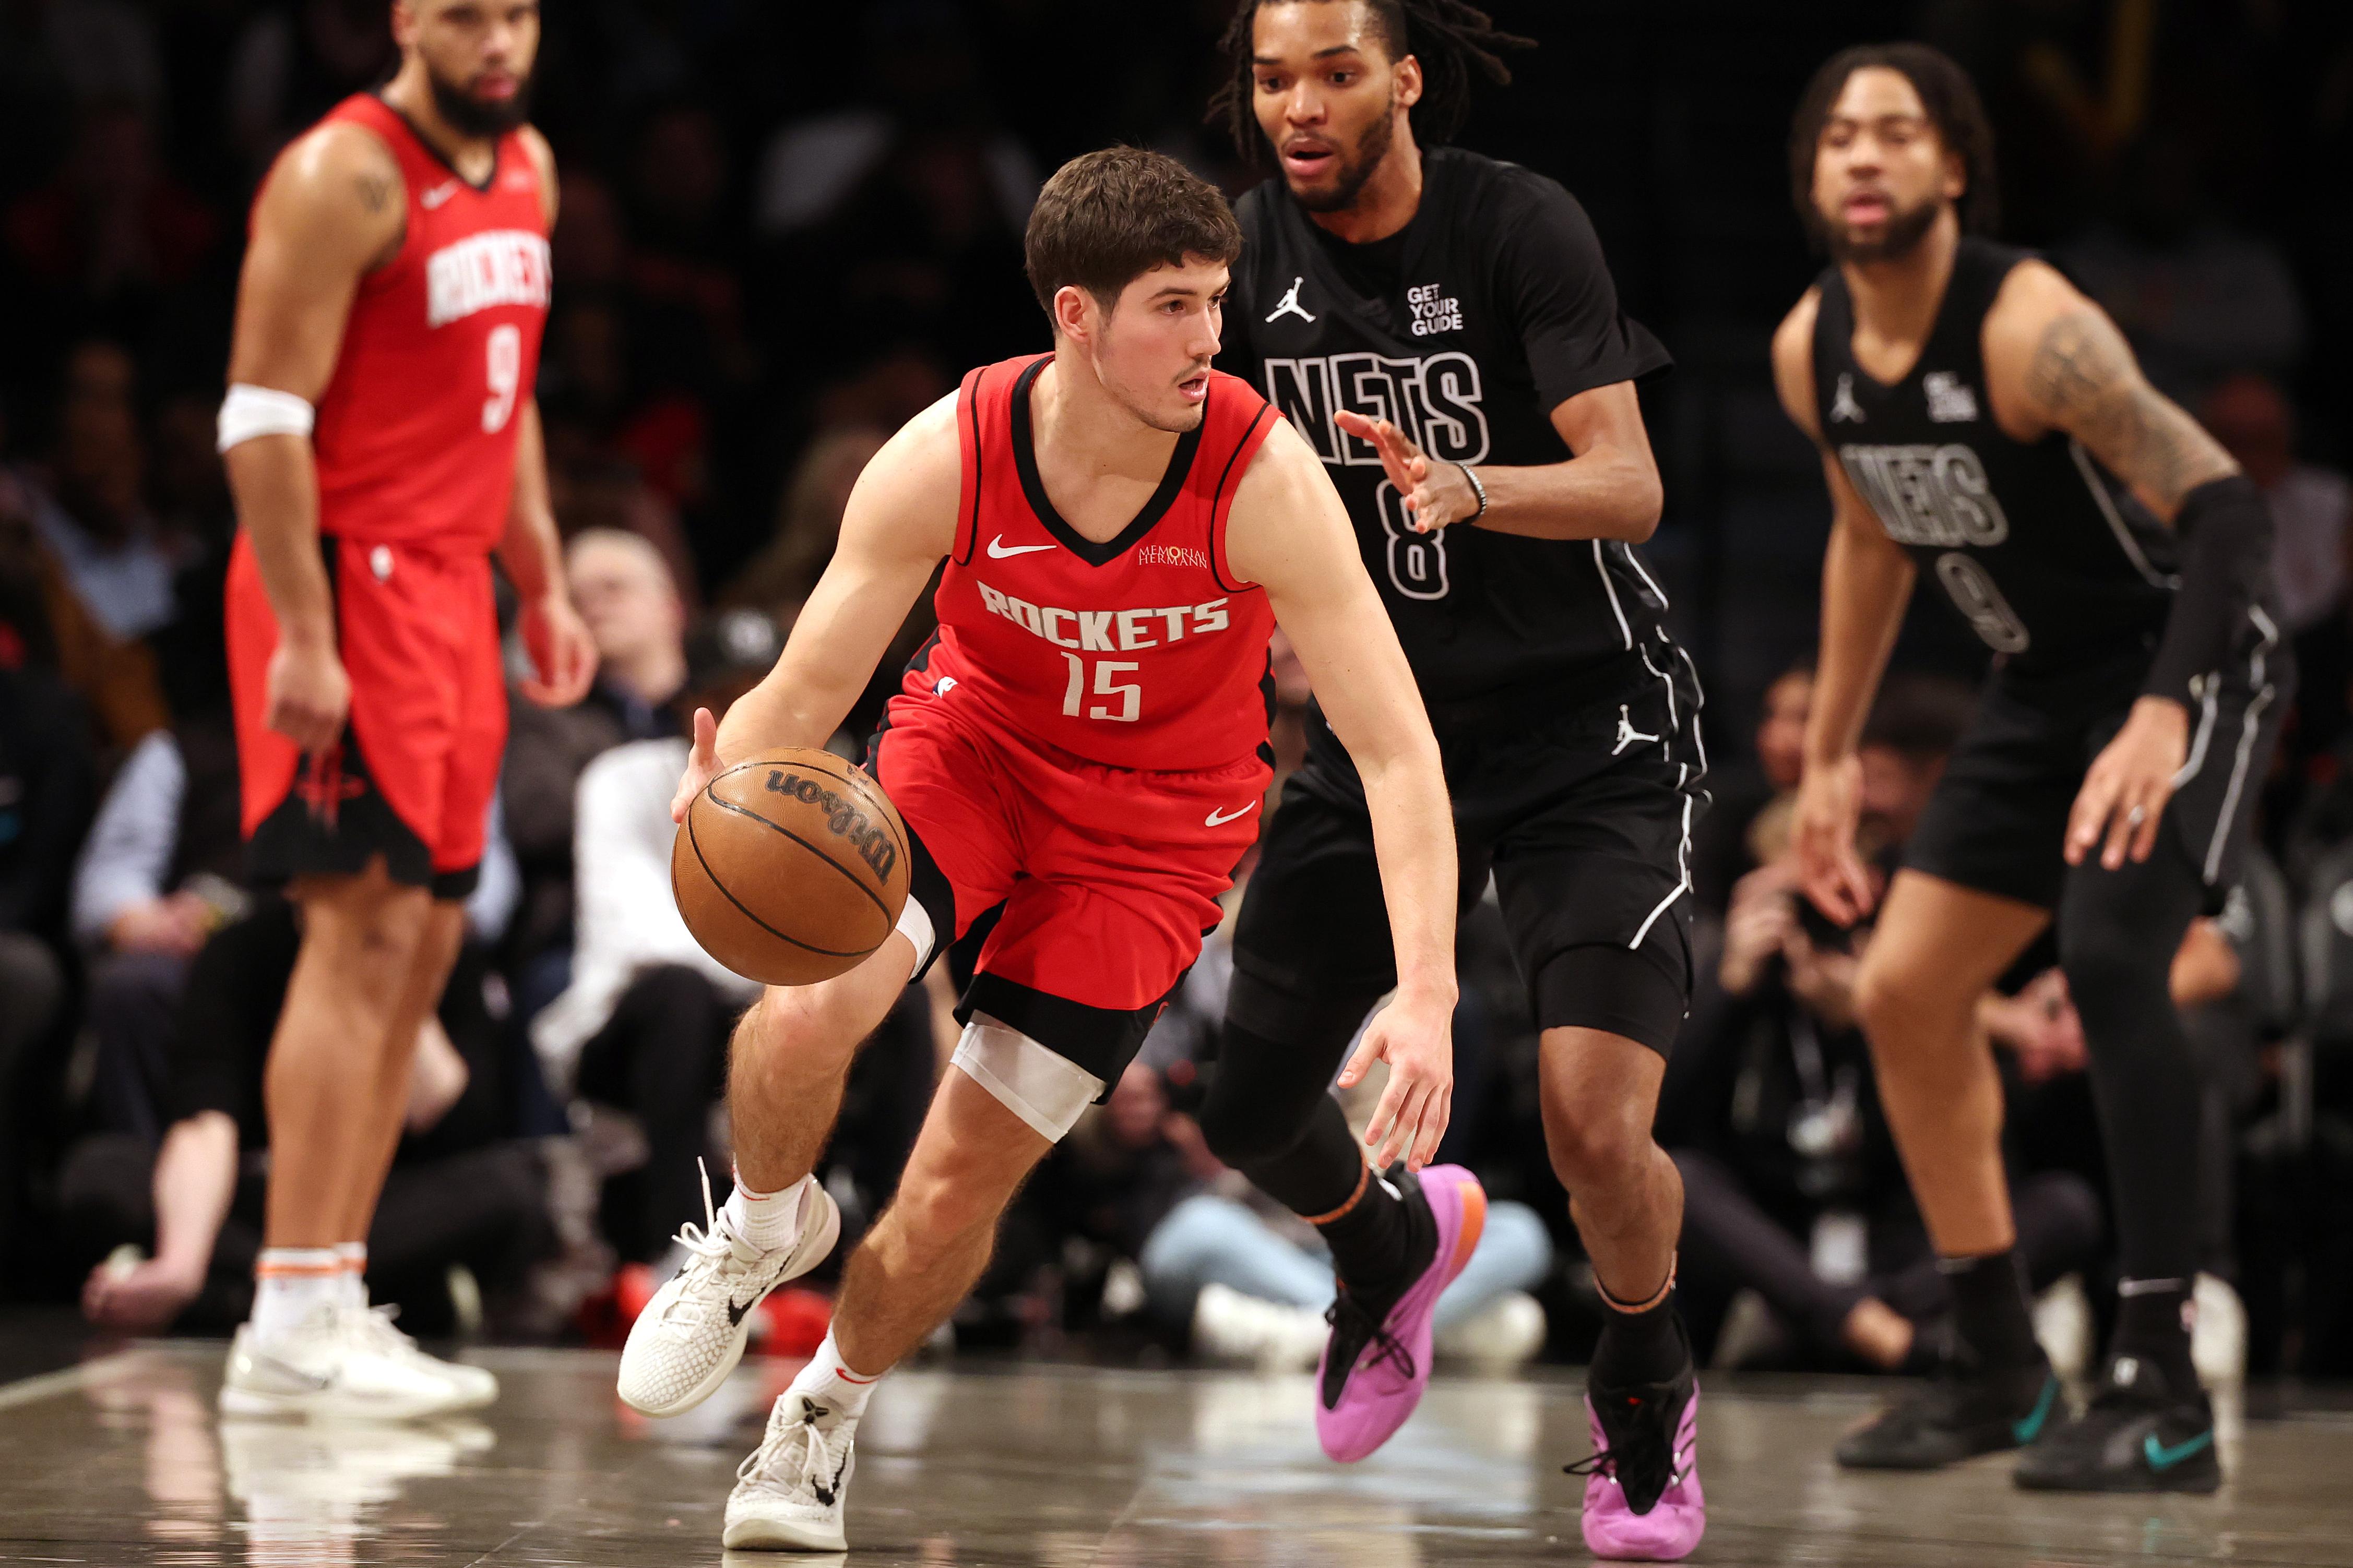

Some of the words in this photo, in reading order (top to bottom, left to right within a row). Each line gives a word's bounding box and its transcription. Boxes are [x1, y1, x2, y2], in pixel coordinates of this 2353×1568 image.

[1407, 283, 1440, 304] GET
[1409, 297, 1459, 319] YOUR
[481, 323, 521, 435] 9
[1264, 351, 1490, 466] NETS
[1838, 443, 2010, 547] NETS
[1139, 545, 1206, 561] MEMORIAL
[1139, 553, 1207, 569] HERMANN
[1376, 478, 1450, 601] 8
[976, 579, 1231, 653] ROCKETS
[1060, 651, 1142, 722] 15
[766, 769, 896, 887] Wilson
